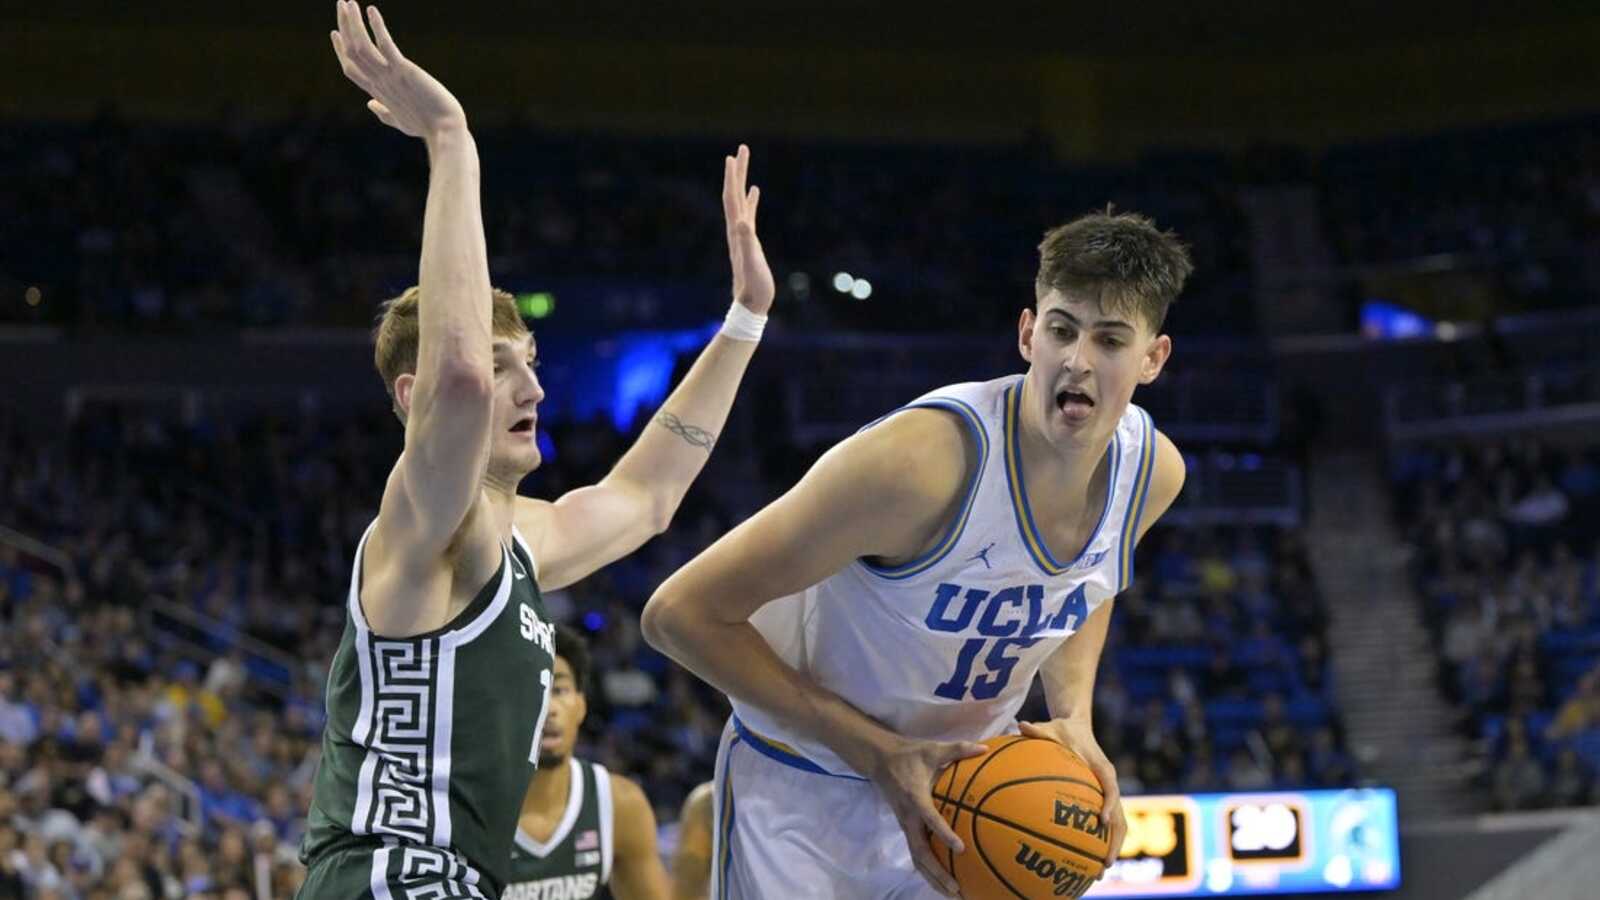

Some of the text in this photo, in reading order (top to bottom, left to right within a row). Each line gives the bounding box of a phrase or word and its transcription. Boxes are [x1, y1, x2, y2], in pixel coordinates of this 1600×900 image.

[925, 582, 1088, 637] UCLA
[934, 637, 1045, 700] 15
[501, 872, 598, 899] PARTANS
